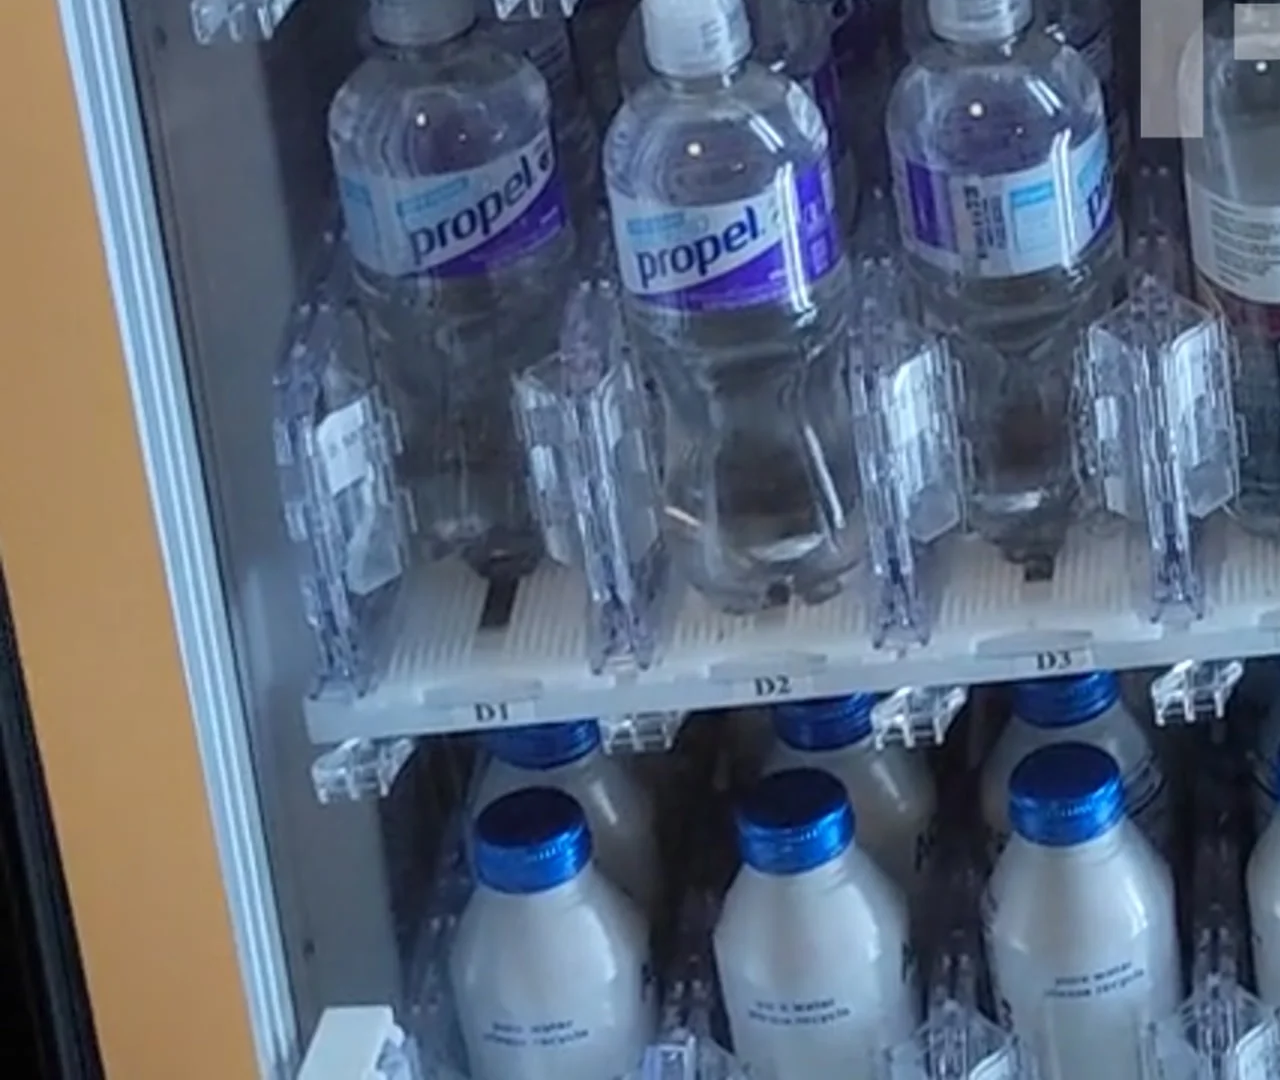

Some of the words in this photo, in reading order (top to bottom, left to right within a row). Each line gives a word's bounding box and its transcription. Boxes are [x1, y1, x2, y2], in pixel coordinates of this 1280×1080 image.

[410, 154, 533, 265] propel
[637, 204, 759, 289] propel
[1036, 651, 1073, 672] D3
[754, 675, 791, 698] D2
[474, 703, 510, 722] D1
